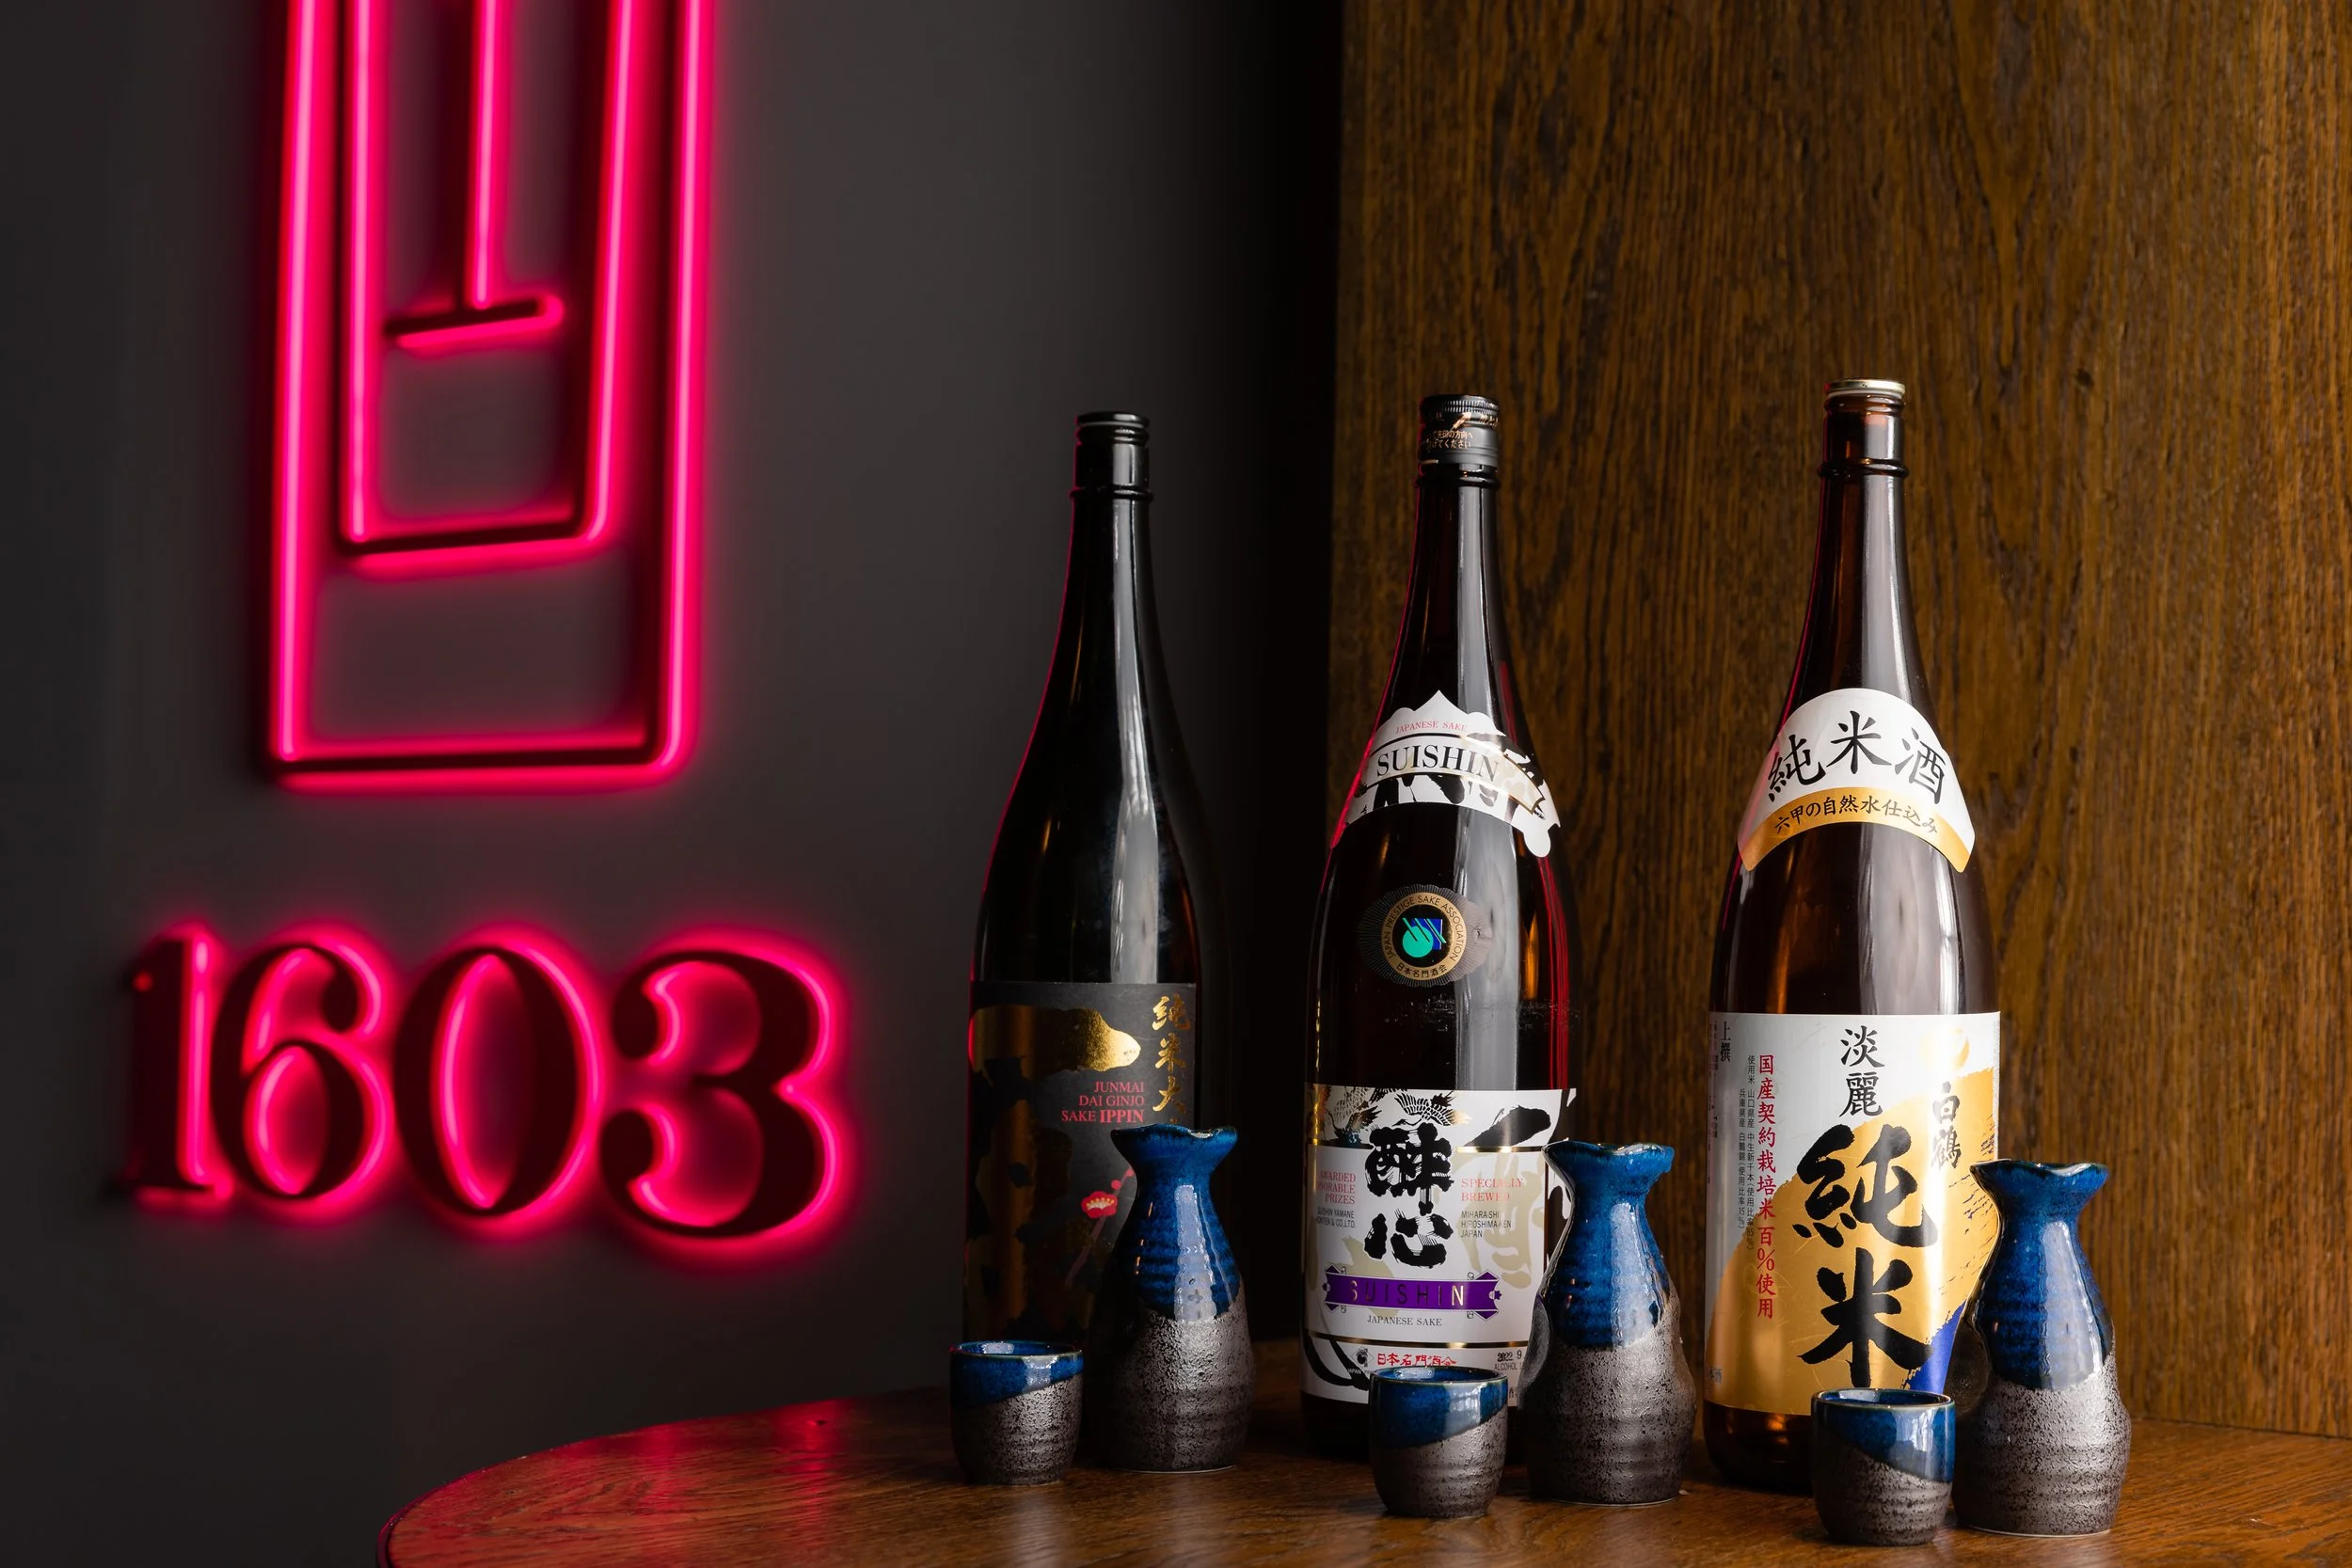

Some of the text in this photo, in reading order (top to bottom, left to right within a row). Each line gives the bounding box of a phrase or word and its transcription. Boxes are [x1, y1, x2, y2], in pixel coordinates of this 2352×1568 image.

[1395, 721, 1468, 734] JAPANESE SAKE
[1376, 743, 1500, 783] SUISHIN
[1768, 710, 1947, 805] 純米酒
[1774, 794, 1938, 834] 六甲の自然水仕込み
[1384, 895, 1464, 961] JAPAN PRESTIGE SAKE ASSOCIATION
[1396, 963, 1447, 978] 日本名門酒会
[1747, 1054, 1756, 1085] 使用米
[1839, 1024, 1885, 1118] 淡麗
[120, 931, 842, 1246] 1603
[1093, 1081, 1145, 1093] JUNMAI
[1078, 1094, 1145, 1107] DAI GINJO
[1747, 1088, 1756, 1129] 山口県産
[1060, 1108, 1145, 1123] SAKE IPPIN
[1931, 1081, 1962, 1170] 白鶴
[1461, 1178, 1522, 1188] SPECIALLY
[1756, 1054, 1777, 1321] 国産契約栽培米百%使用
[1325, 1193, 1356, 1205] PRIZES
[1461, 1192, 1511, 1202] BREWED
[1334, 1209, 1355, 1219] YAMANE
[1460, 1229, 1483, 1239] JAPAN
[1792, 1123, 1939, 1389] 純米
[1349, 1279, 1465, 1307] SUISHIN
[1367, 1315, 1442, 1326] JAPANESE SAKE
[1494, 1362, 1518, 1371] ALCOHOL
